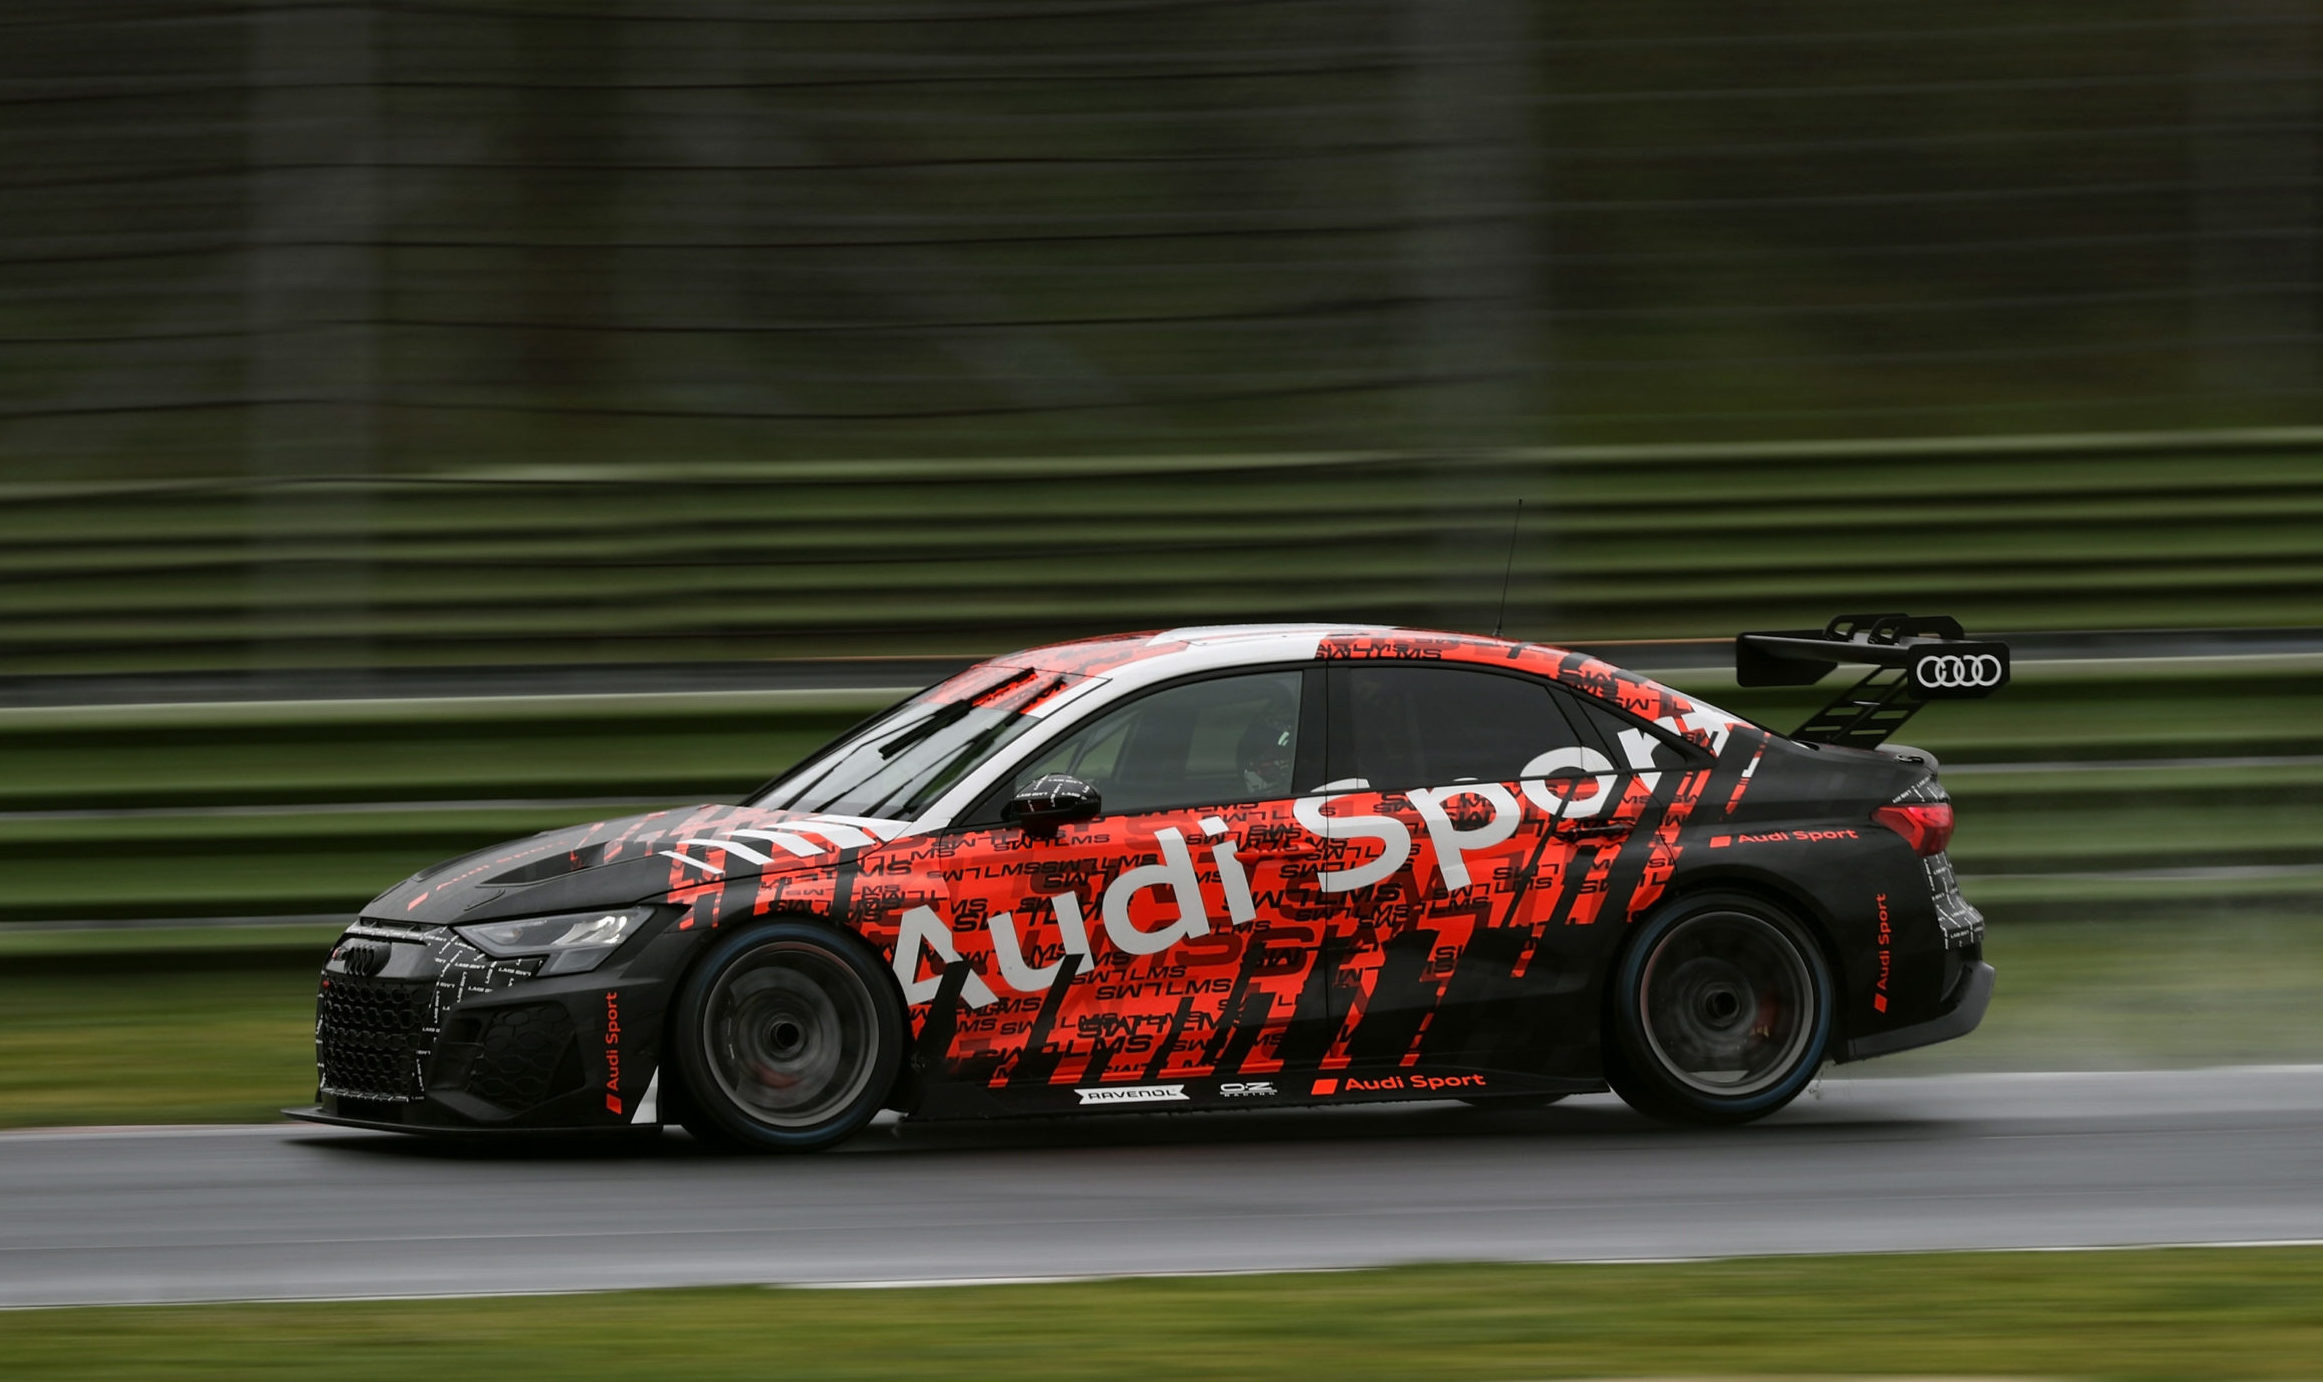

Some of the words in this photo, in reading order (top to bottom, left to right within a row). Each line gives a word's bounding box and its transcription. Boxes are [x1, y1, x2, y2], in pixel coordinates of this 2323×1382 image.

[893, 816, 1257, 1010] Audi
[1291, 696, 1763, 893] Sport
[1738, 830, 1789, 843] Audi
[1793, 829, 1859, 843] Sport
[1876, 893, 1892, 945] Sport
[1166, 978, 1232, 996] LMS
[1876, 950, 1890, 990] Audi
[605, 991, 621, 1045] Sport
[606, 1050, 620, 1092] Audi
[1345, 1076, 1402, 1091] Audi
[1405, 1073, 1487, 1091] Sport
[1088, 1089, 1177, 1101] RAVENOL
